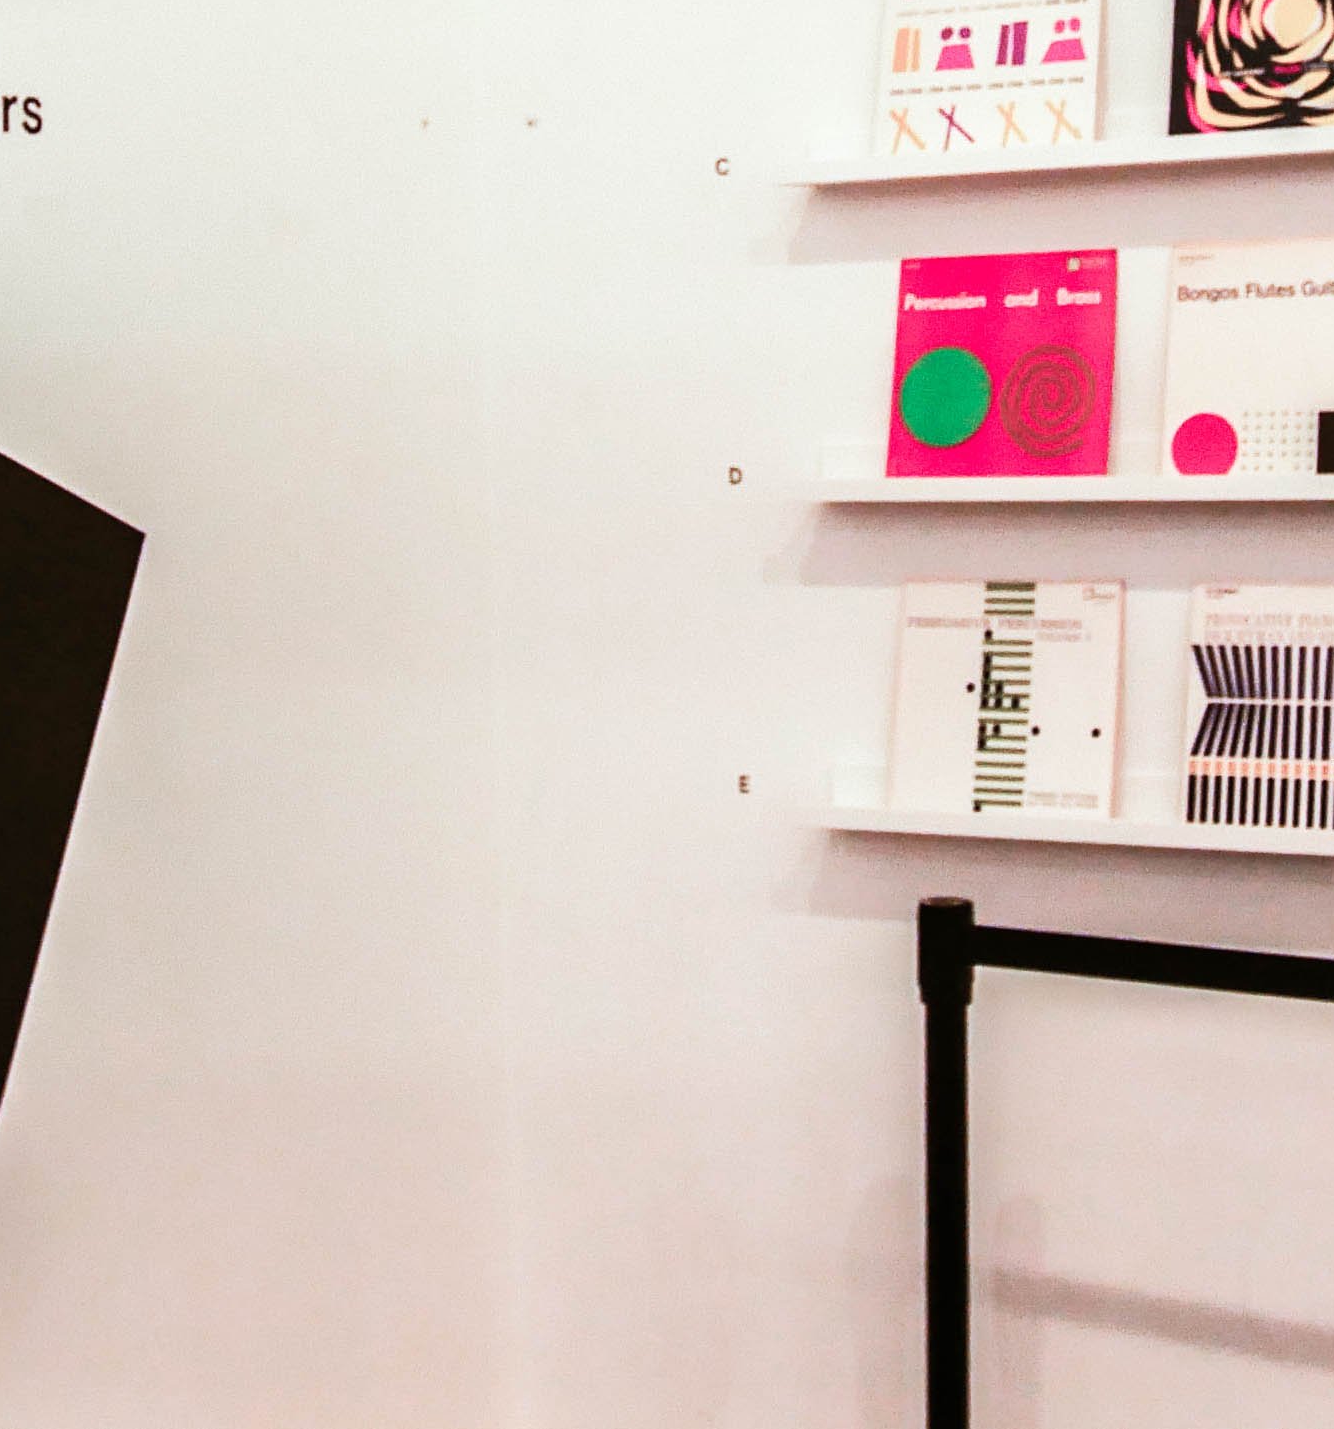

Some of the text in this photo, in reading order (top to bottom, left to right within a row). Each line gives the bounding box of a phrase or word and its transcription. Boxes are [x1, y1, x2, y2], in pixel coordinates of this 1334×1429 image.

[716, 158, 729, 175] C
[1004, 289, 1039, 308] and
[1177, 284, 1240, 303] Bongos
[1245, 281, 1296, 299] Flutes
[729, 467, 742, 485] D
[739, 775, 749, 793] E
